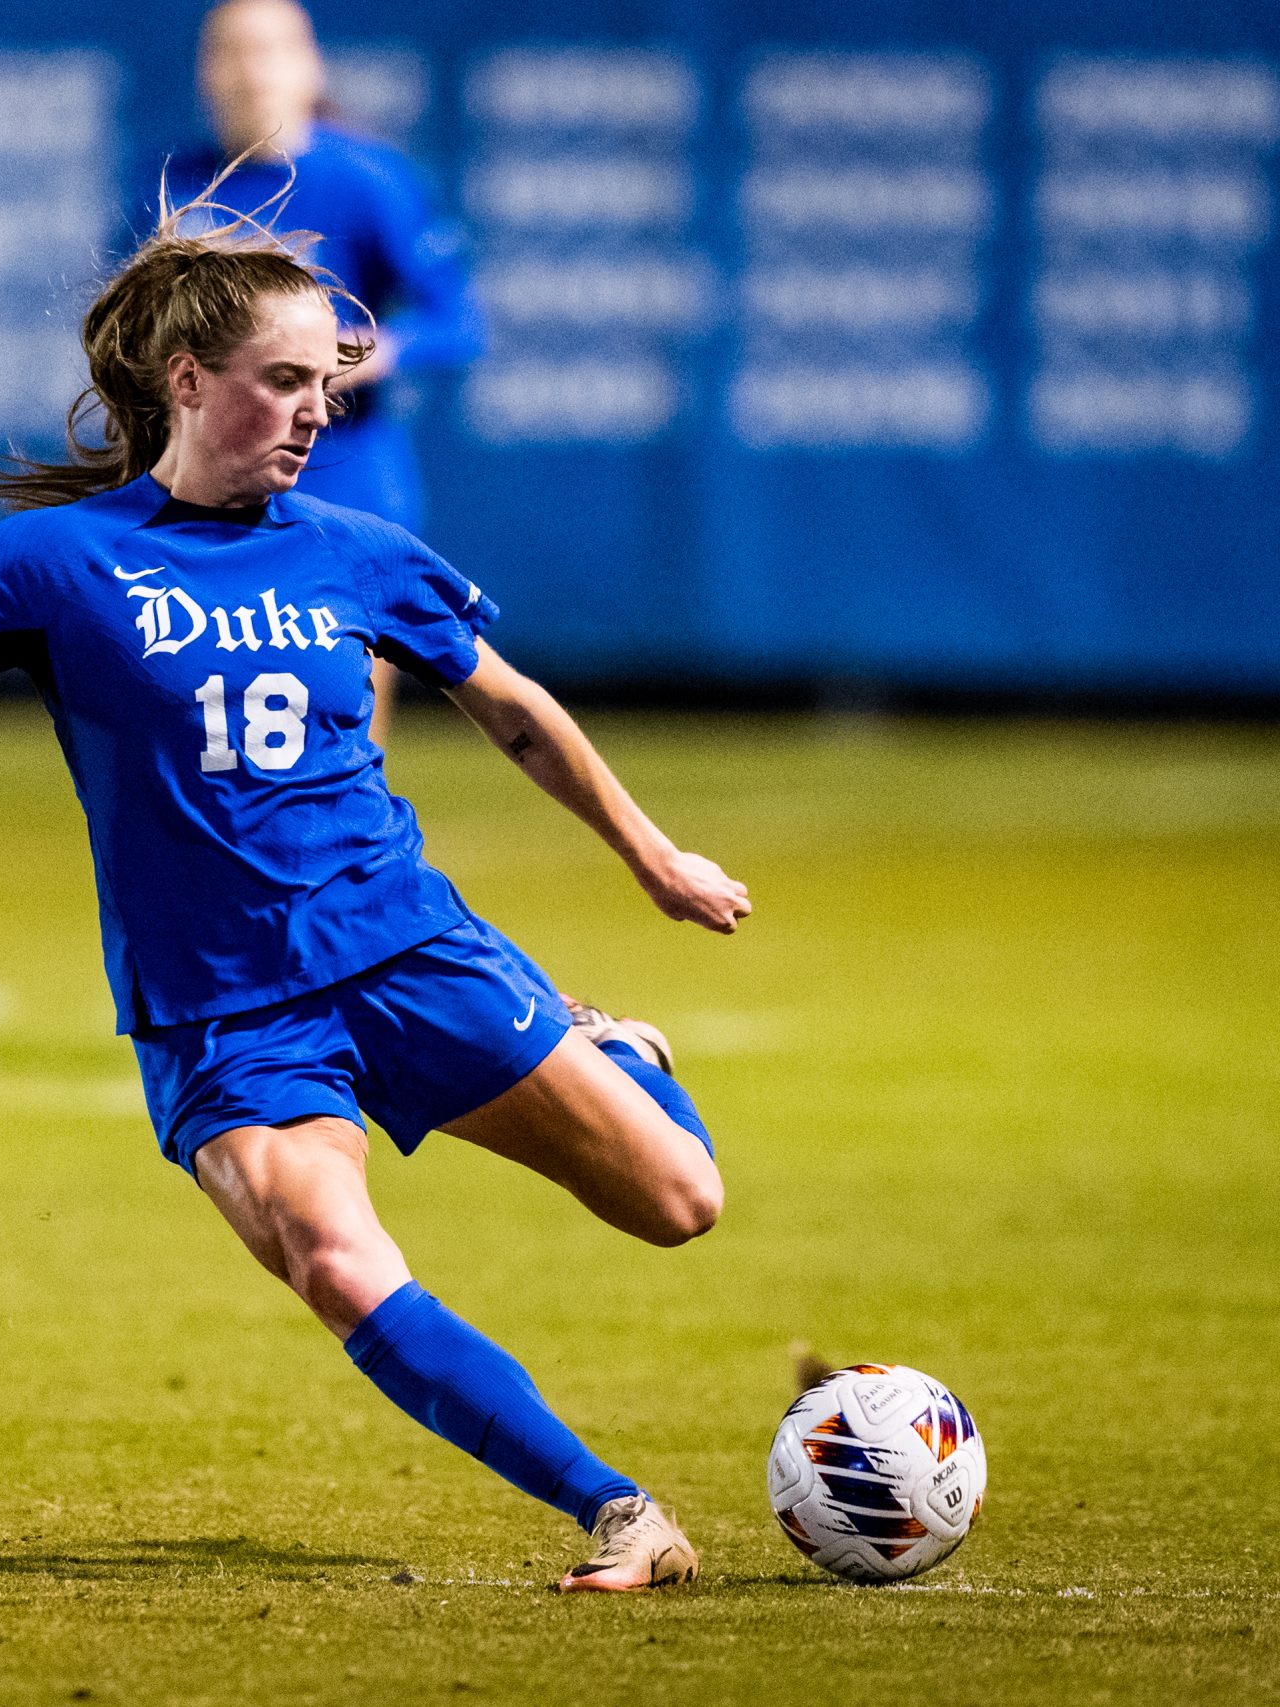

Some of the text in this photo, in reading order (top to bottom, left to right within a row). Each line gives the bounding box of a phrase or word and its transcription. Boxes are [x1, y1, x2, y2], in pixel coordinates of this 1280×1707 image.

[127, 587, 341, 659] Duke
[195, 672, 309, 772] 18
[932, 1461, 958, 1486] NCAA
